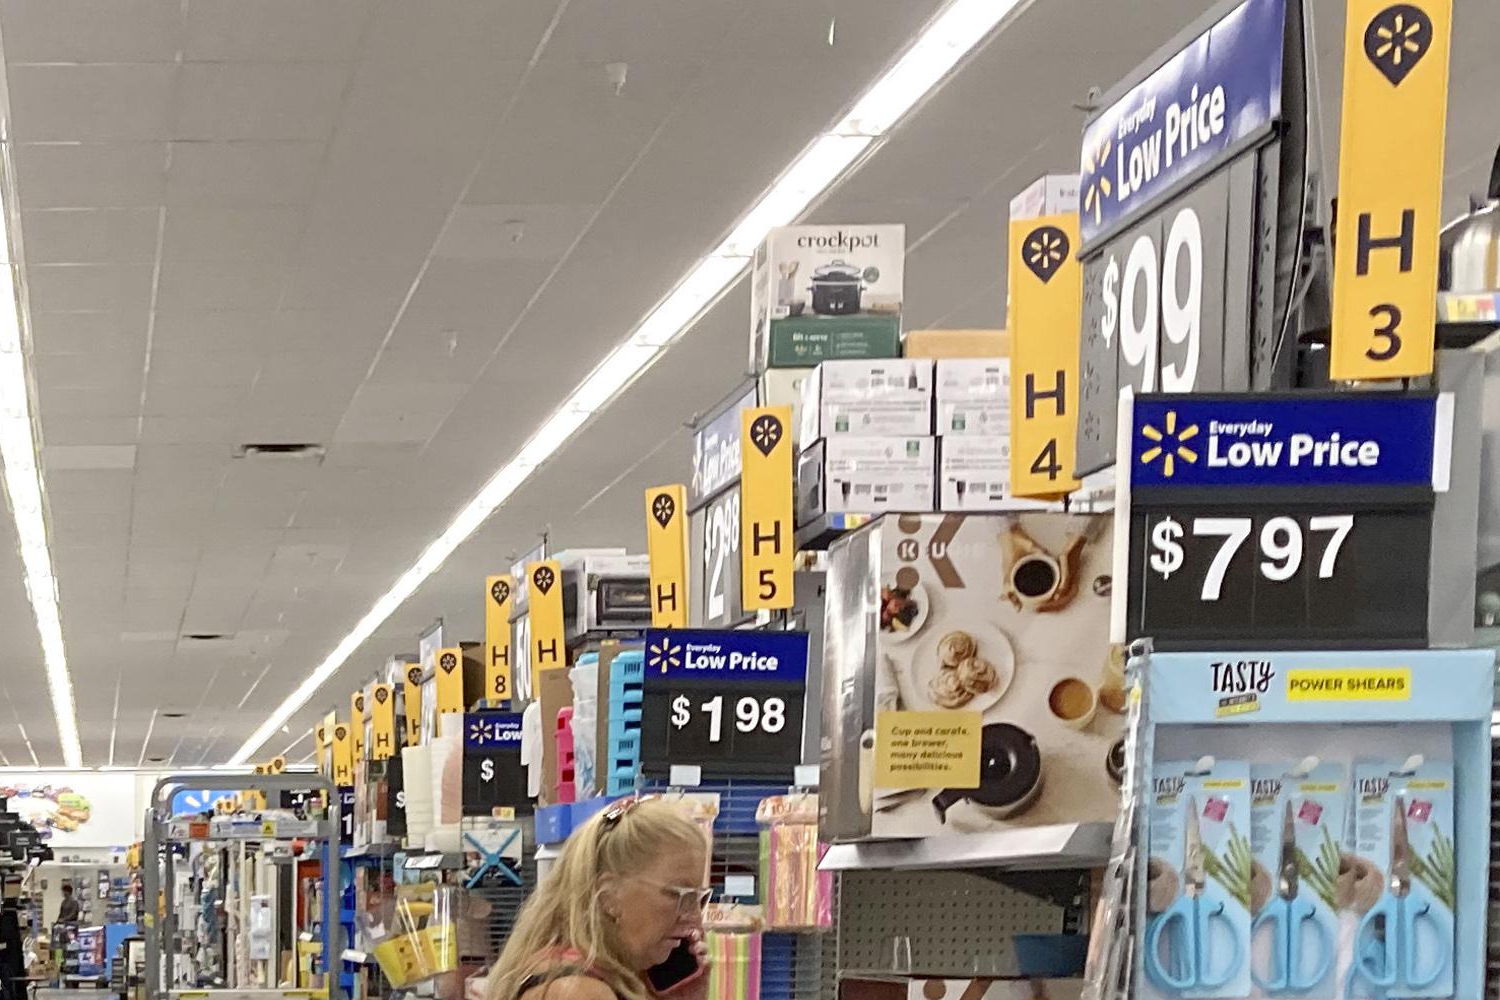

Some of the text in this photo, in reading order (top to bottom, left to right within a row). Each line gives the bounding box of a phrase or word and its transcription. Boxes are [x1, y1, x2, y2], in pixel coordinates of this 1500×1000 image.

[1116, 82, 1225, 200] Low Price
[797, 231, 879, 255] crockpot
[1356, 208, 1414, 360] H 3
[1025, 369, 1066, 481] H 4
[1209, 420, 1273, 438] Everyday
[1207, 431, 1380, 468] Low Price
[752, 520, 782, 601] H 5
[657, 583, 677, 614] H
[538, 639, 557, 663] H
[685, 643, 722, 656] Everyday
[685, 648, 779, 672] Low Price
[492, 645, 509, 694] H 8
[1210, 660, 1276, 694] TASTY
[1290, 676, 1405, 692] POWER SHEARS
[377, 732, 389, 748] H
[495, 729, 522, 742] Low
[914, 727, 932, 735] and
[338, 765, 348, 778] H
[480, 759, 494, 783] $
